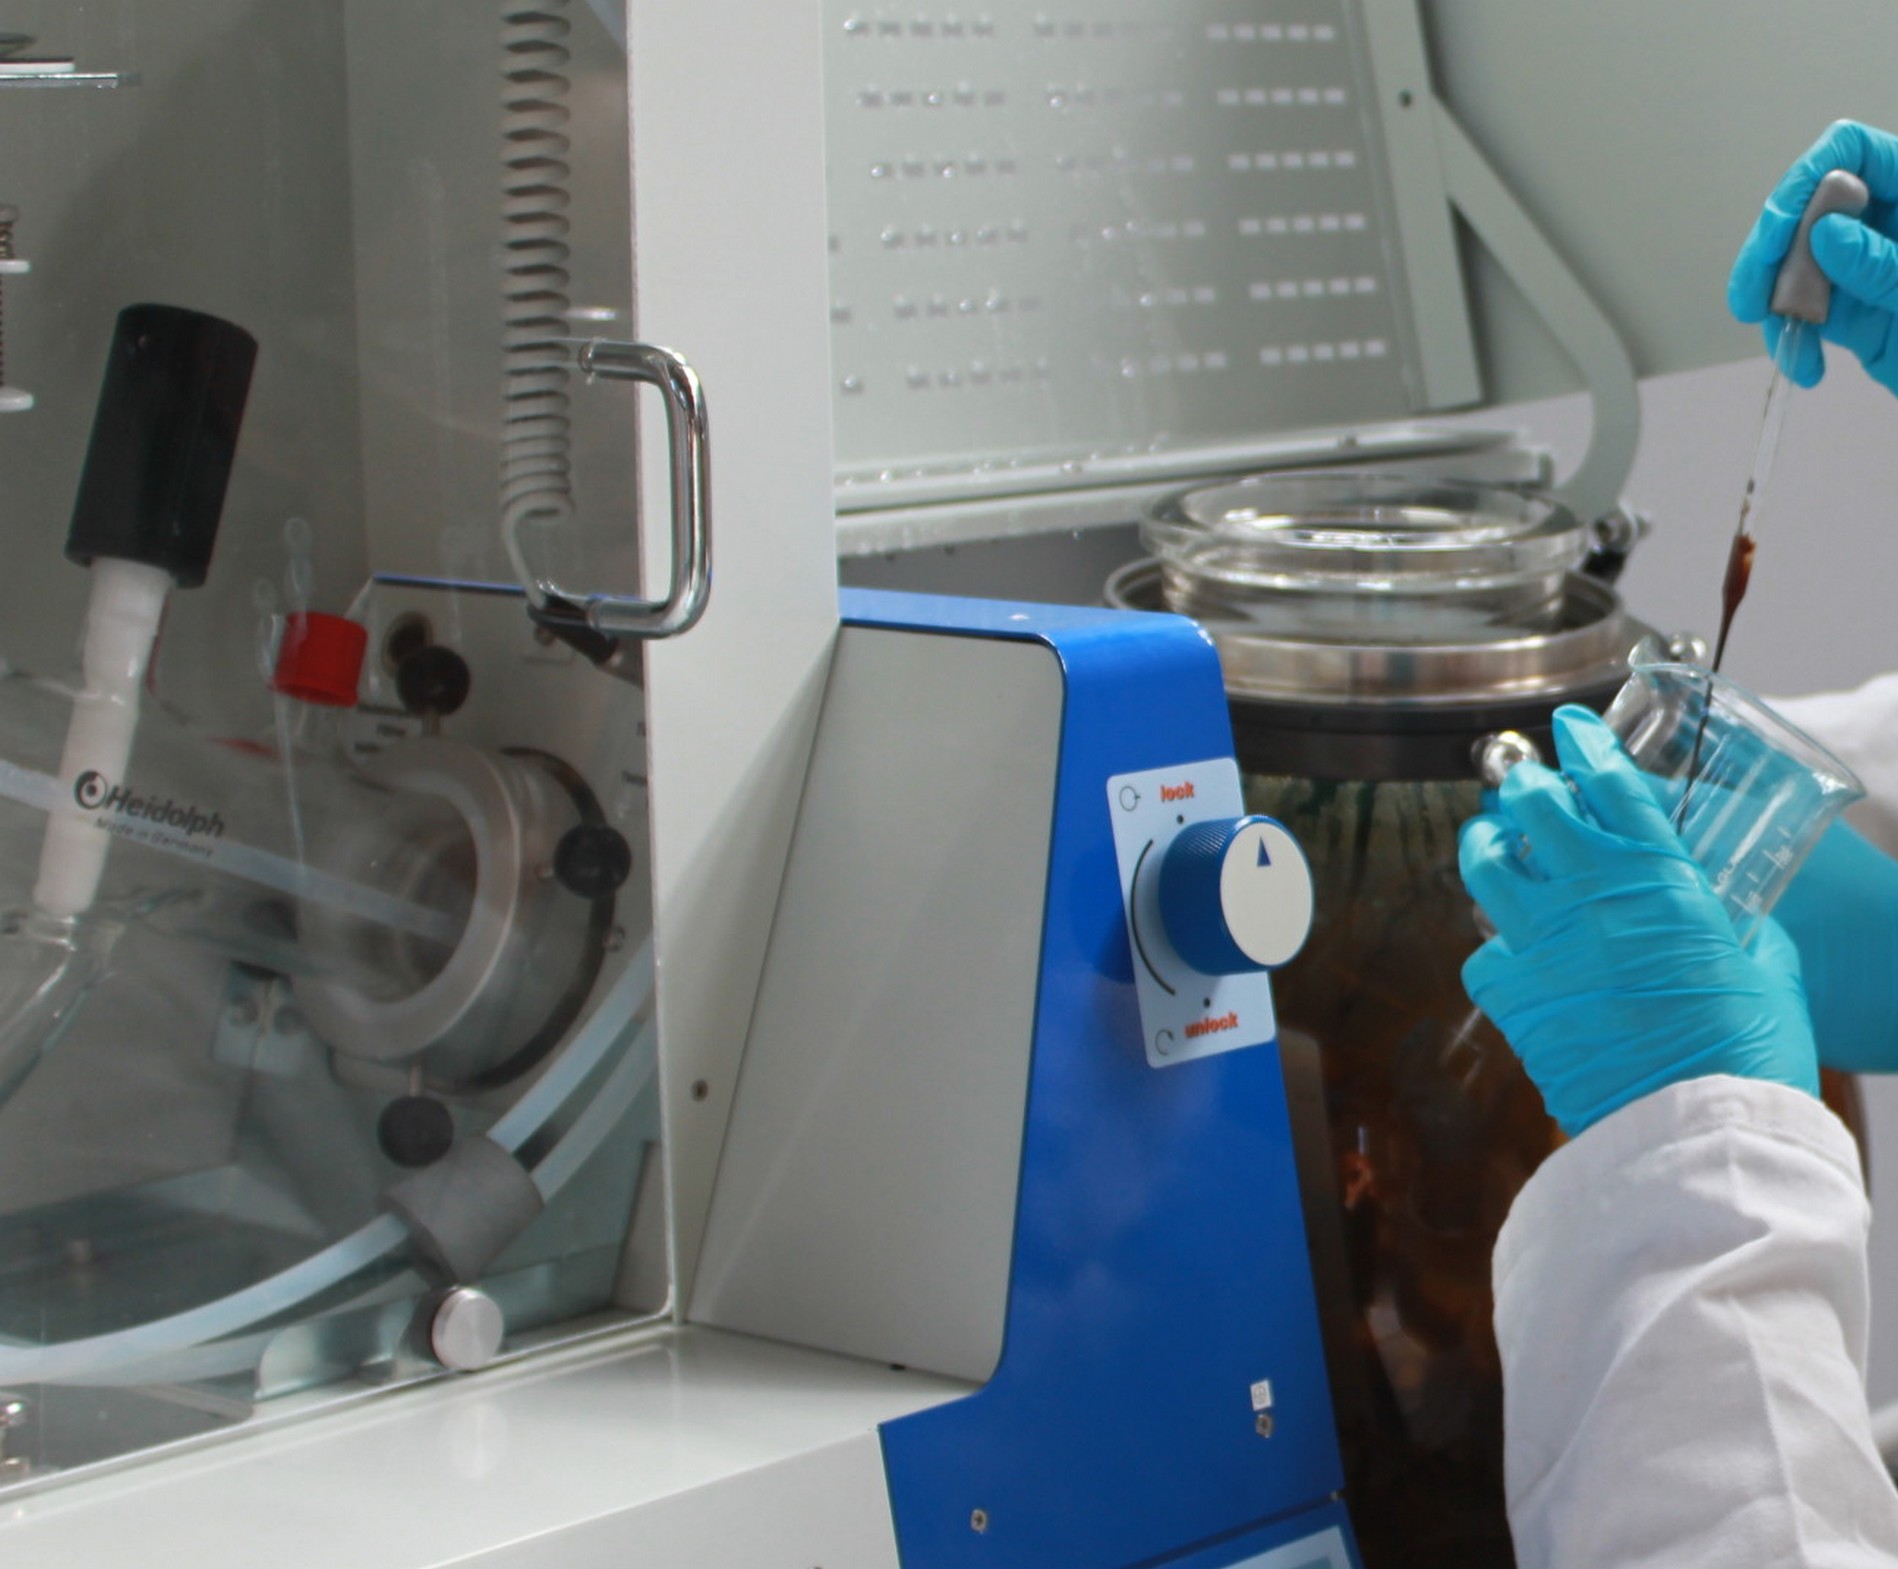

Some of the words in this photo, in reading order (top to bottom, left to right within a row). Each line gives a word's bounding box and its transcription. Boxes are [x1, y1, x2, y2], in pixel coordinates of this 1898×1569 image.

[1161, 780, 1195, 802] lock
[105, 785, 225, 837] Heidolph
[1184, 1010, 1239, 1038] unlock
